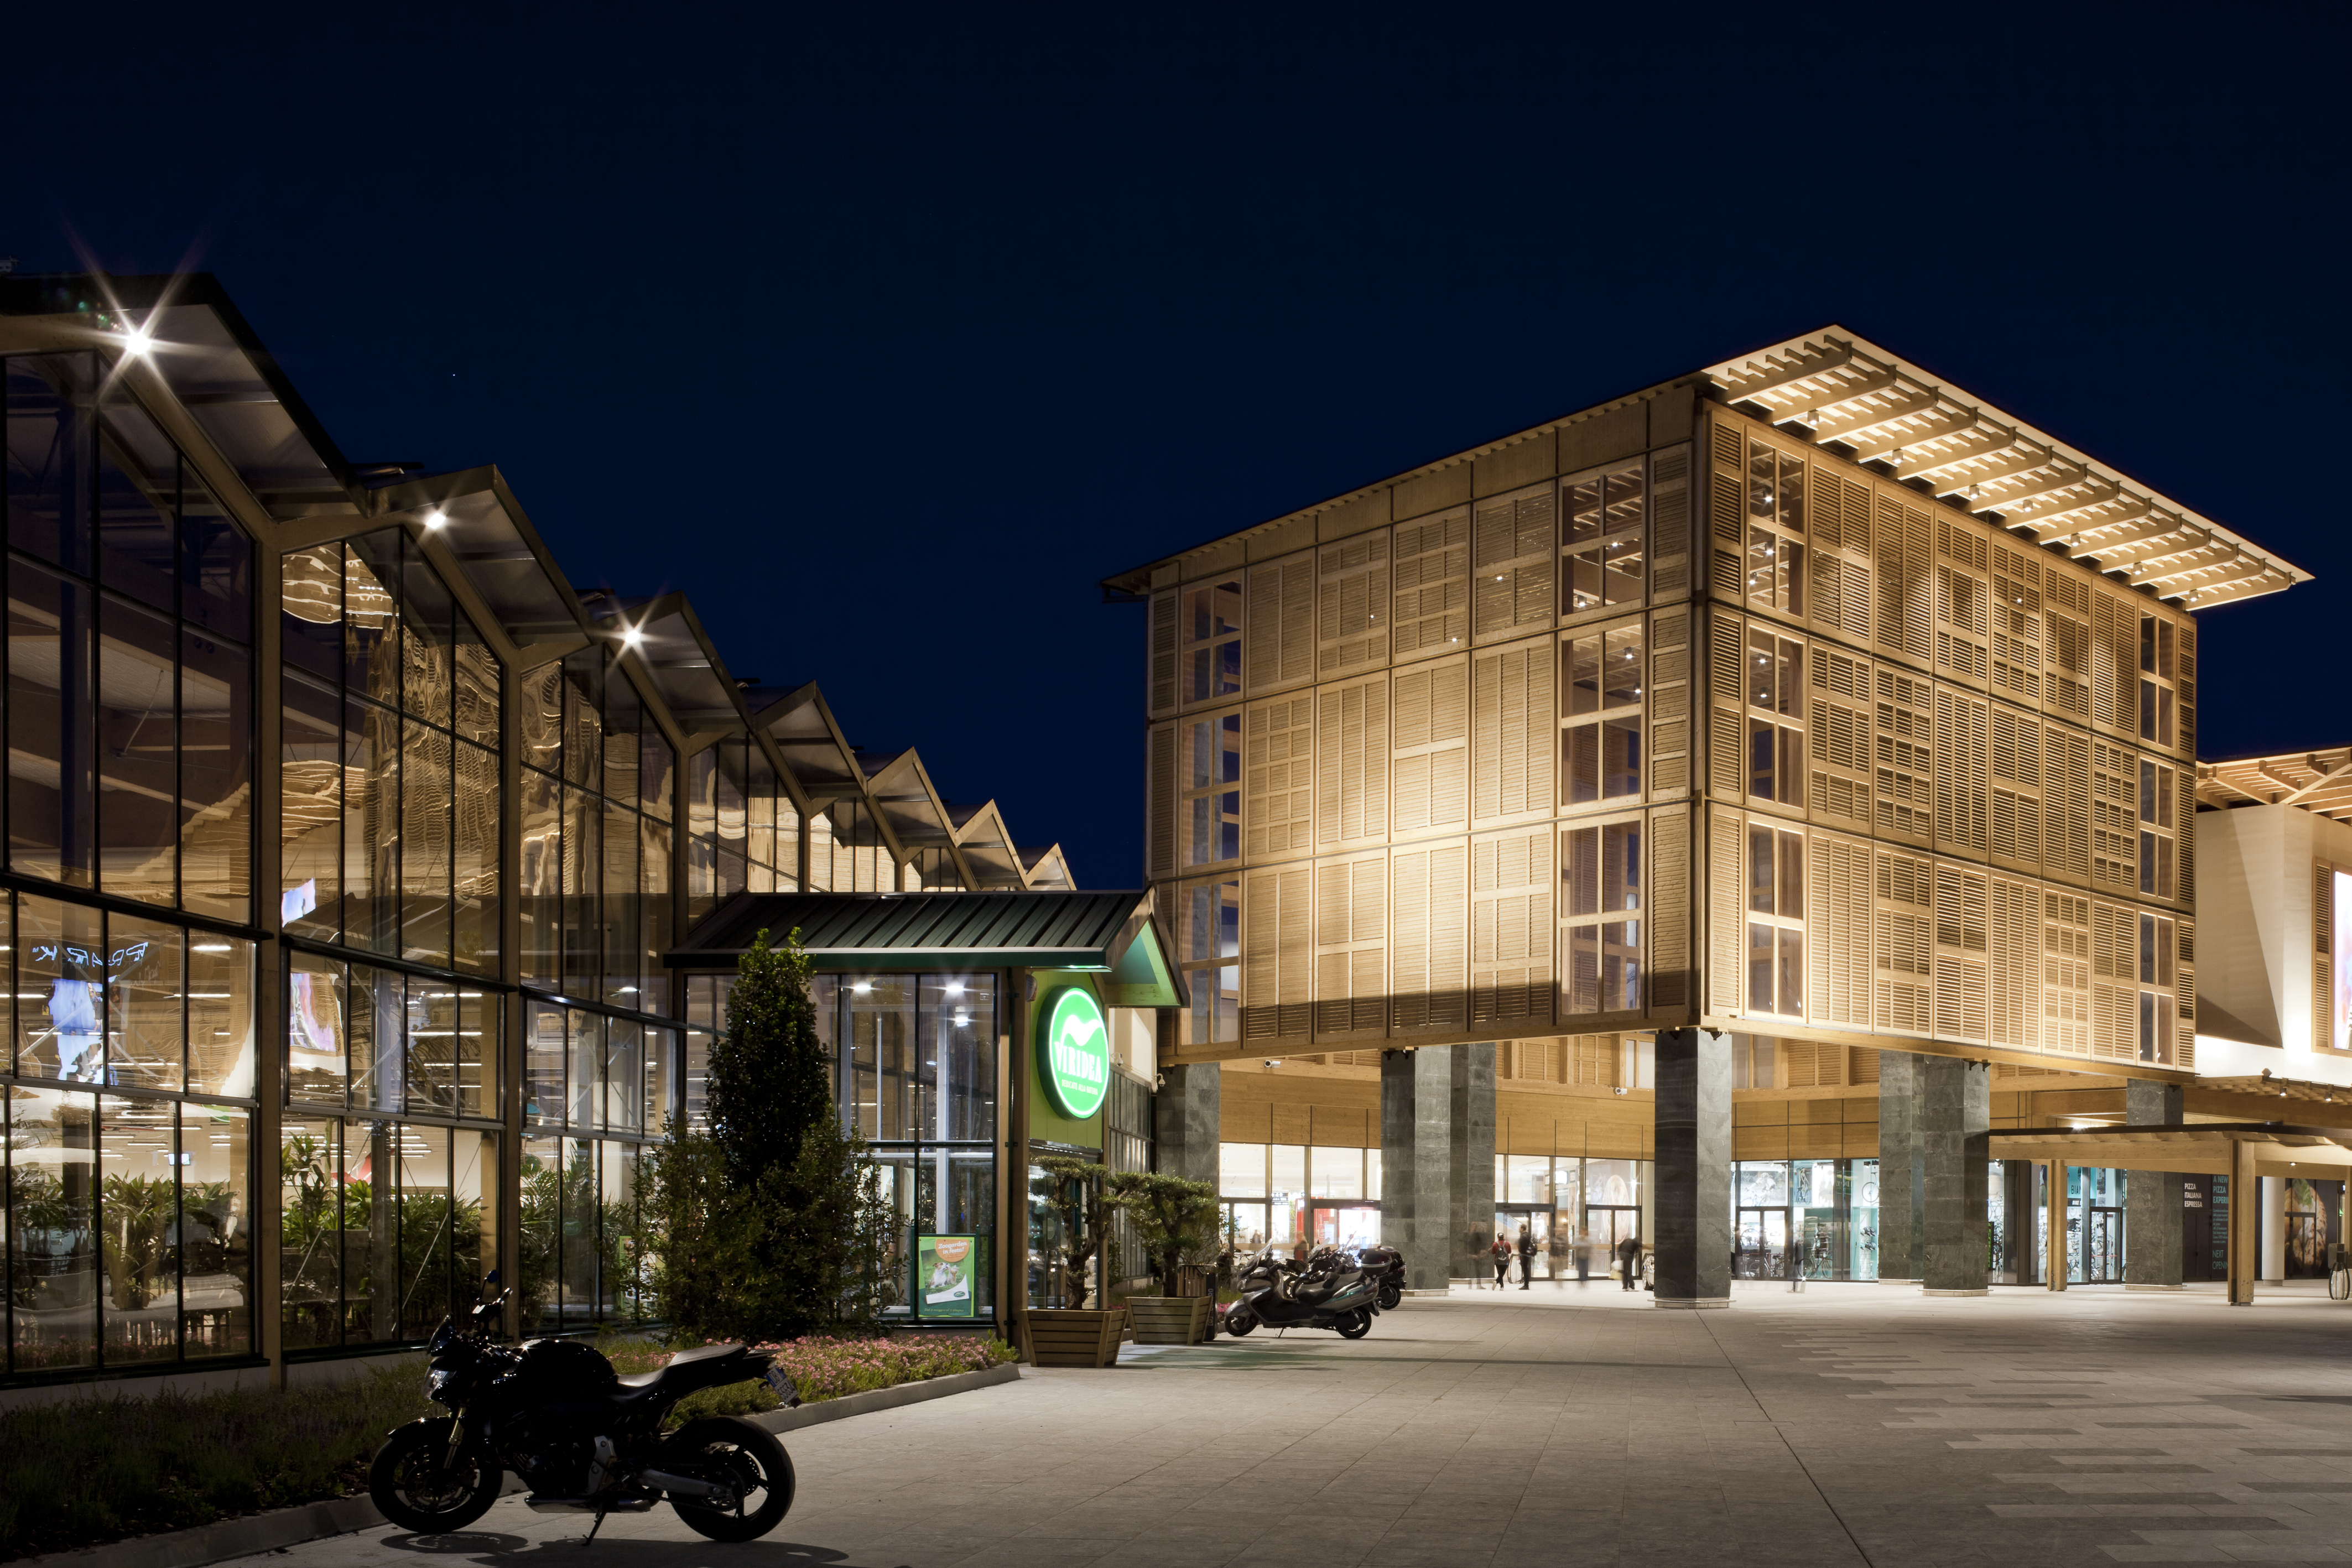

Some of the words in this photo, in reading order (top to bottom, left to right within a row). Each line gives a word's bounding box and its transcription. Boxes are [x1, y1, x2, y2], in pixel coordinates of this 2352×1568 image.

[1054, 1041, 1102, 1083] VIRIDEA
[1061, 1079, 1078, 1090] DEDICATO
[1086, 1086, 1098, 1096] NATURA
[938, 1241, 967, 1249] Zoogarden
[2212, 1249, 2224, 1258] NEXT
[768, 1371, 780, 1384] DB
